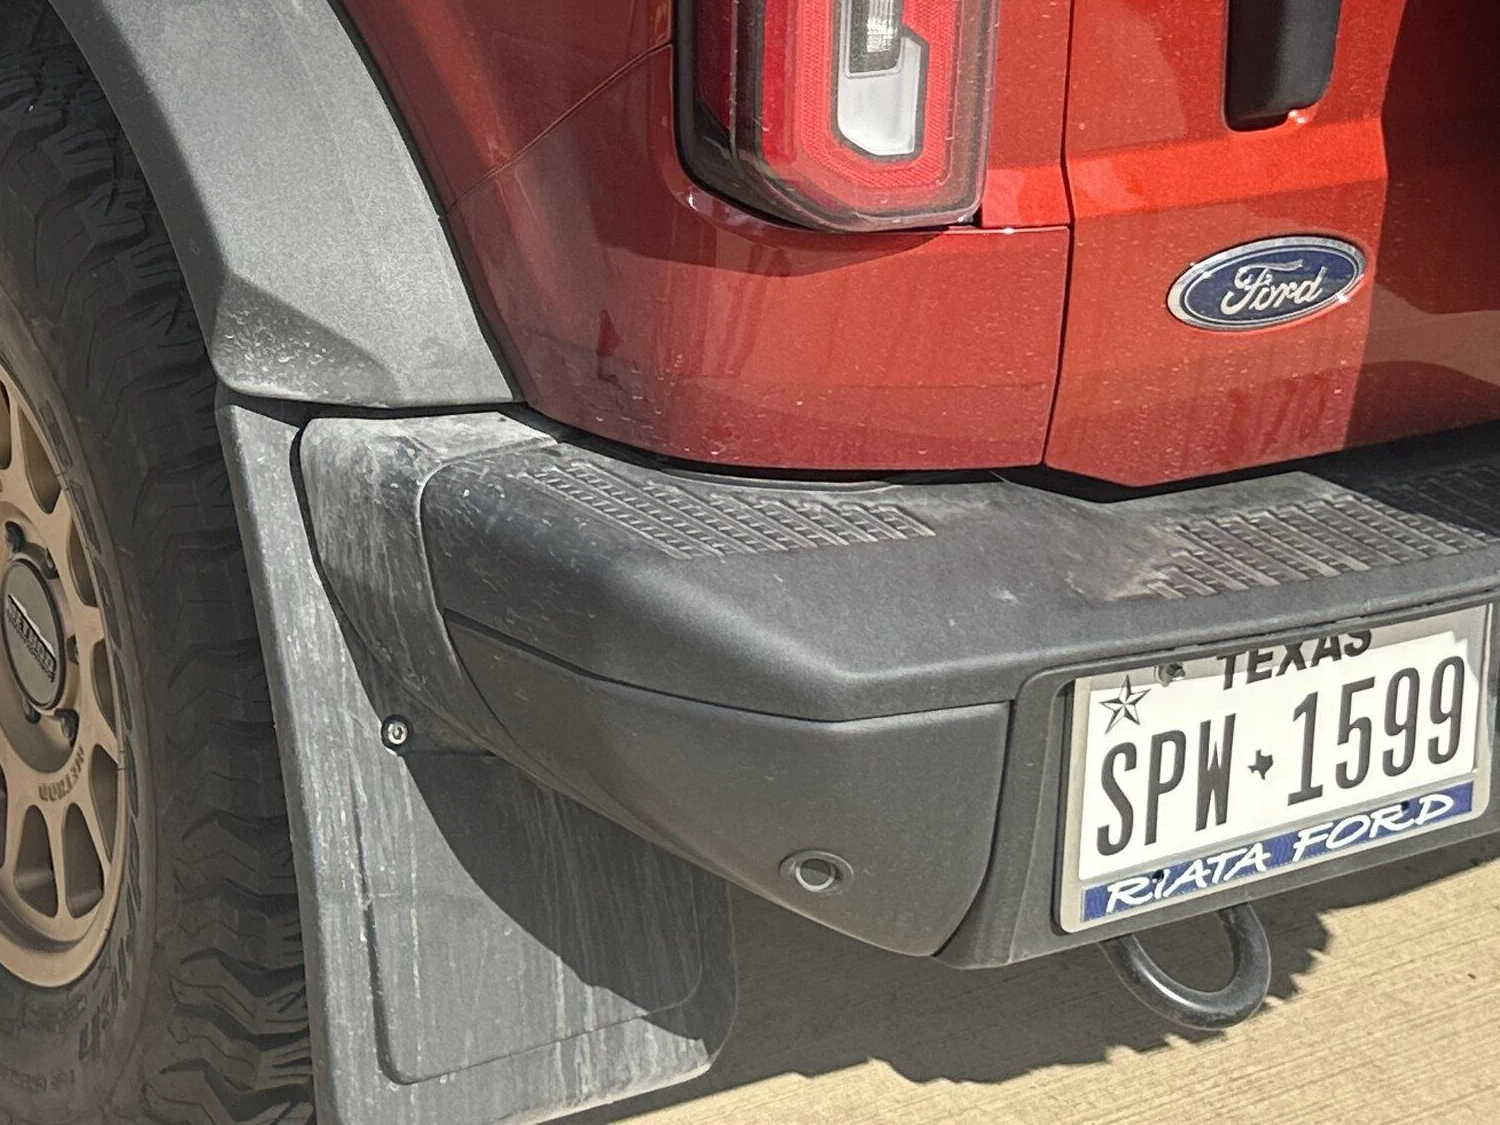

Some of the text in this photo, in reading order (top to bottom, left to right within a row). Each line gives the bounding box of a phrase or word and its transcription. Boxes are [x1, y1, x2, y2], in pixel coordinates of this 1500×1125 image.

[1220, 259, 1328, 316] Ford
[1216, 629, 1372, 691] TEXAS
[1096, 655, 1466, 857] SPW 1599
[1105, 793, 1456, 915] RIATA FORD
